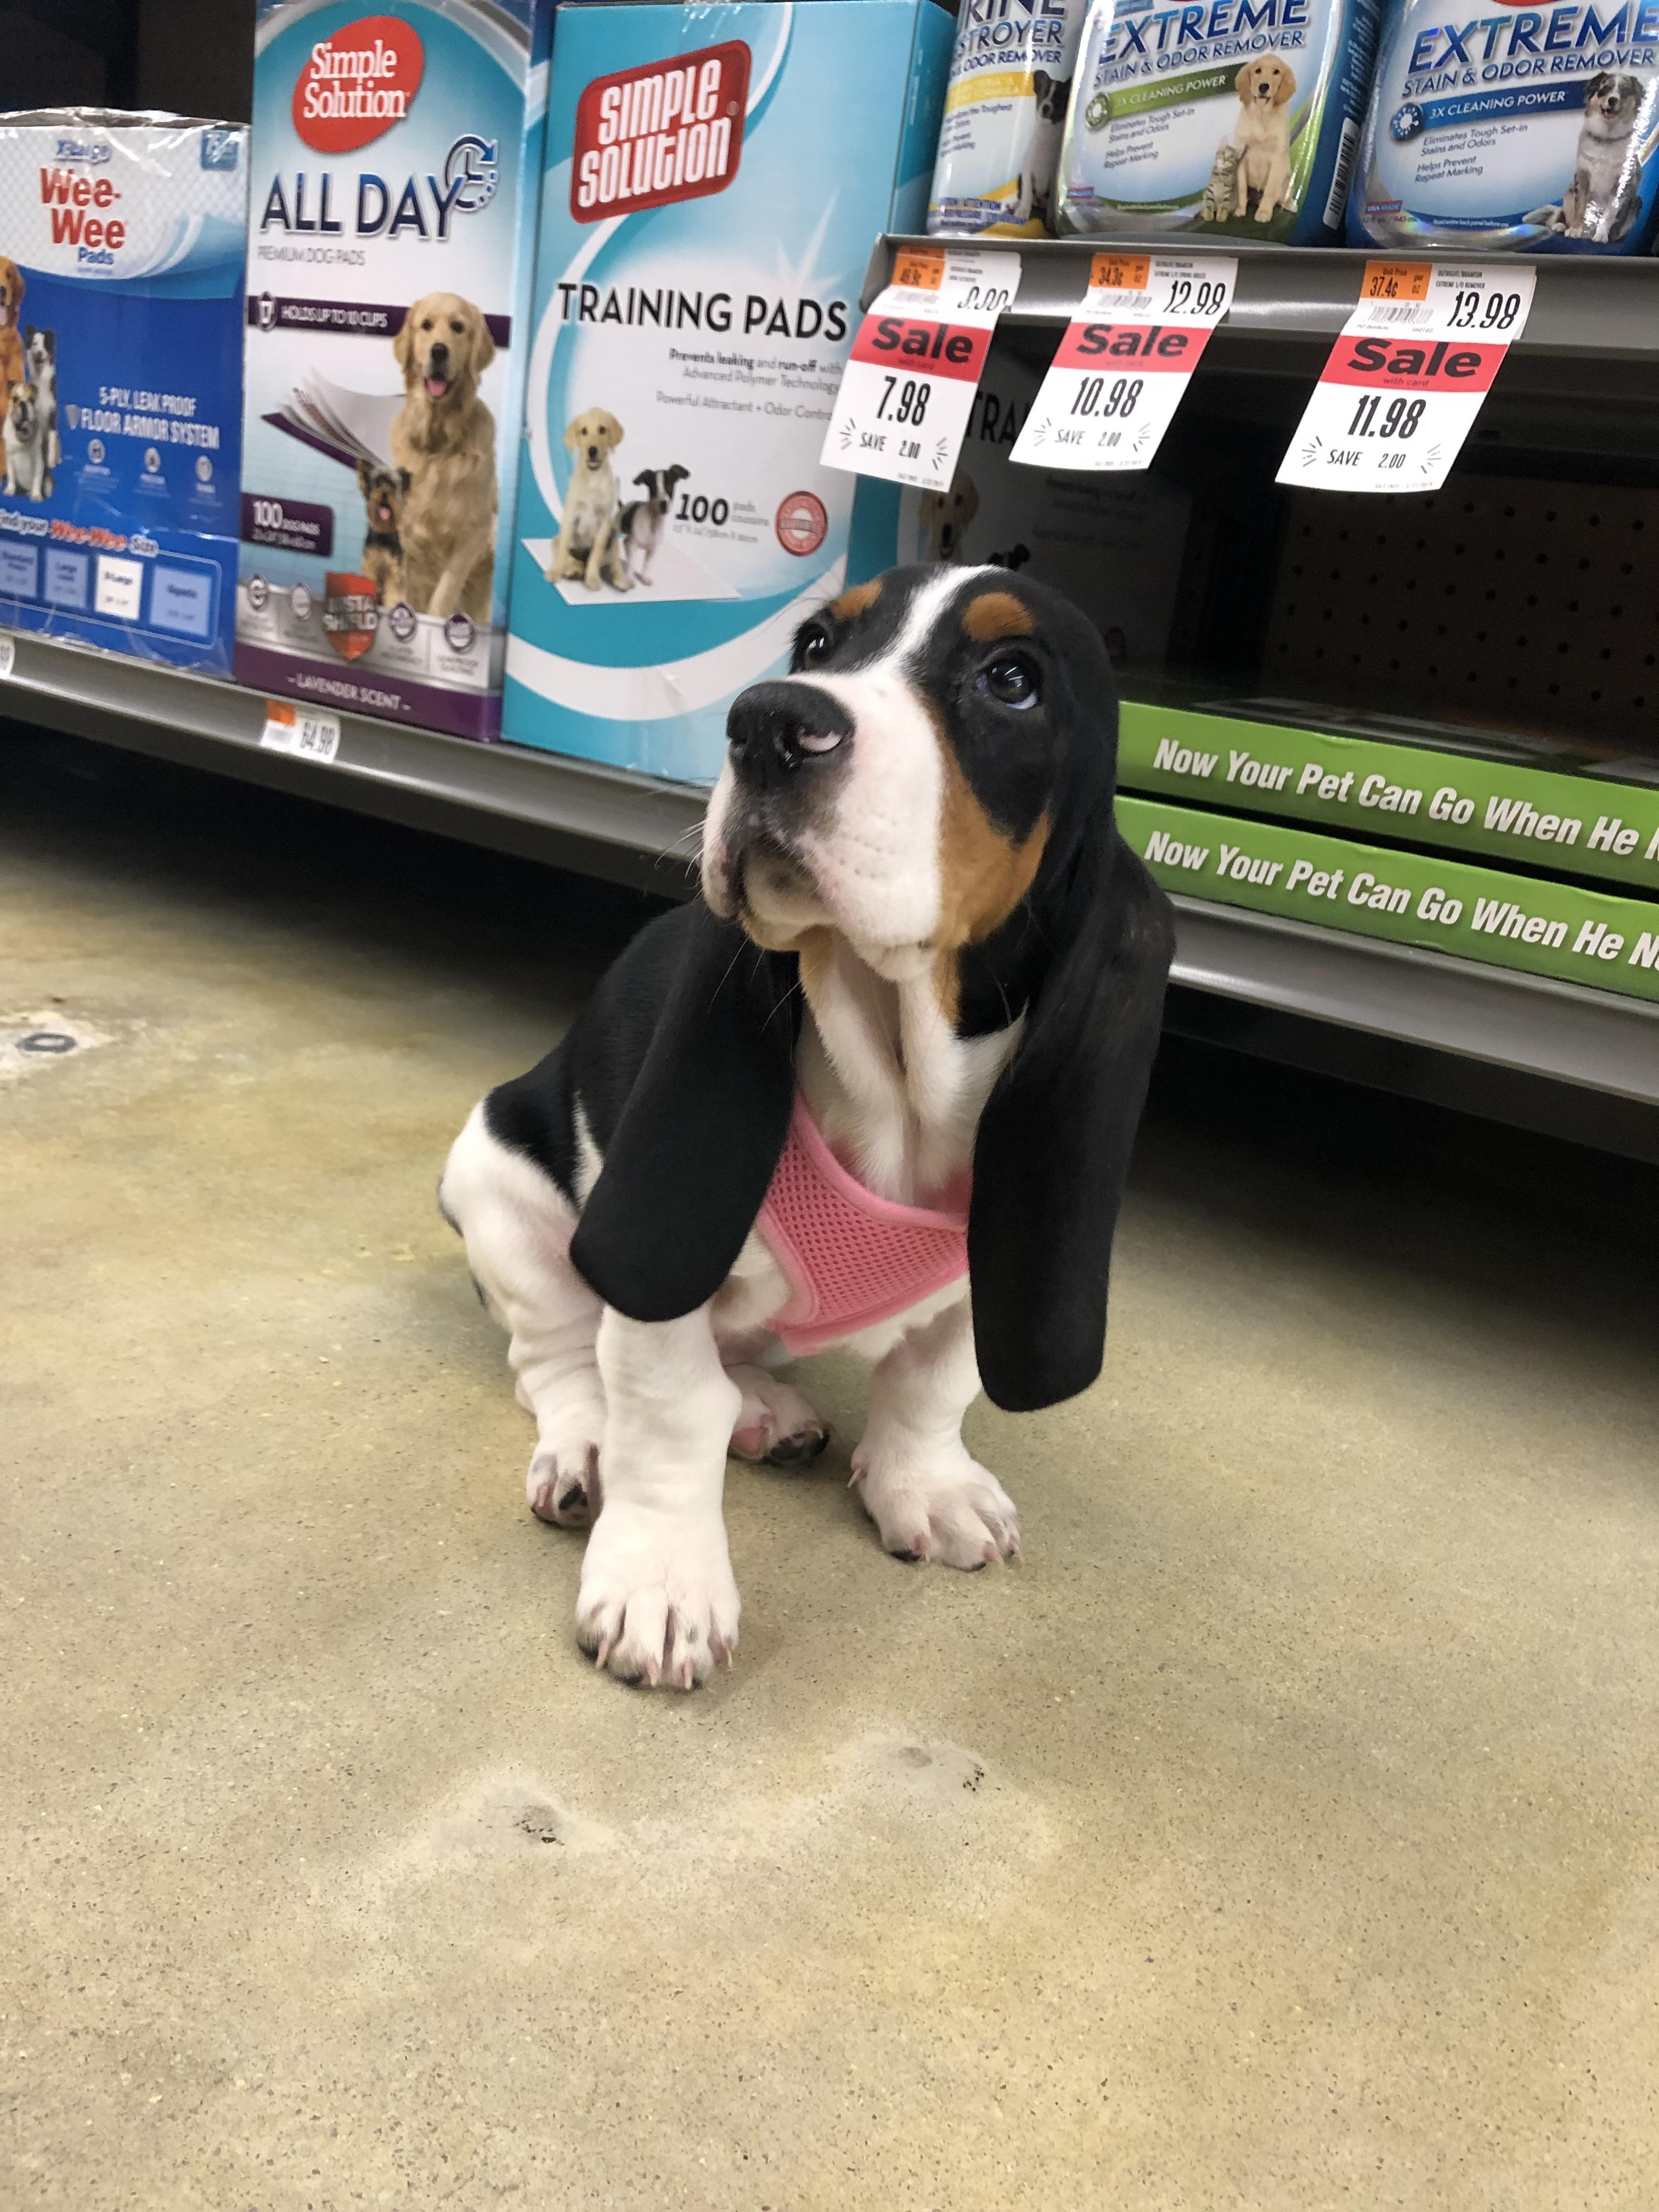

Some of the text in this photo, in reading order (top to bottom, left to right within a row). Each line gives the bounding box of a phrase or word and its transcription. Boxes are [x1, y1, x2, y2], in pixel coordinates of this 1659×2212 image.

[1099, 0, 1307, 64] EXTREME
[1408, 0, 1659, 74] EXTREME
[310, 40, 397, 85] Simple
[998, 50, 1062, 64] REMOVER
[1094, 30, 1304, 89] STAIN & ODOR REMOVER
[1403, 48, 1655, 99] STAIN & ODOR REMOVER
[303, 80, 407, 119] Solution
[1130, 84, 1184, 104] CLEANING
[1186, 75, 1226, 92] POWER
[1429, 91, 1566, 119] 3X CLEANING POWER
[1146, 123, 1169, 134] Odors
[1148, 112, 1170, 123] Tough
[1421, 138, 1496, 156] Stains and Odors
[1424, 123, 1528, 146] Eliminates Tough Set-in
[1415, 165, 1483, 183] Repeat Marking
[1417, 156, 1477, 173] Helps Prevent
[261, 172, 465, 239] ALL DAY
[51, 207, 125, 249] Wee
[78, 247, 114, 264] Pads
[558, 283, 848, 341] TRAINING PADS
[1163, 280, 1226, 315] 12.98
[1447, 291, 1521, 329] 13.98
[359, 311, 388, 328] CUPS
[871, 318, 973, 363] Sale
[1077, 324, 1188, 357] Sale
[669, 348, 715, 363] Prevents
[716, 351, 754, 370] leaking
[756, 354, 777, 369] and
[778, 359, 817, 373] run-off
[1347, 338, 1482, 378] Sale
[683, 366, 733, 382] Advanced
[734, 369, 777, 387] Polymer
[1383, 376, 1430, 387] with card
[133, 390, 162, 413] LEAK
[161, 394, 196, 417] PROOF
[656, 390, 699, 408] Powerful
[702, 396, 754, 413] Attractant
[764, 402, 792, 416] Odor
[794, 405, 832, 421] Contro
[876, 375, 931, 426] 7.98
[1071, 377, 1144, 417] 10.98
[81, 407, 219, 450] FLOOR ARMOR SYSTEM
[1348, 394, 1426, 439] 11.98
[860, 431, 887, 452] SAVE
[1055, 429, 1122, 447] SAVE 2.00
[1327, 449, 1406, 469] SAVE 2.00
[252, 500, 284, 529] 100
[675, 493, 729, 526] 100
[296, 673, 402, 711] LAVENDER SCENT
[1153, 738, 1219, 778] Now
[1227, 750, 1294, 791] Your
[1296, 763, 1354, 803] Pet
[1358, 774, 1423, 815] Can
[1429, 786, 1475, 825] Go
[1484, 795, 1582, 845] When
[1587, 816, 1640, 855] He
[1144, 831, 1659, 972] Now Your Pet Can Go When He N
